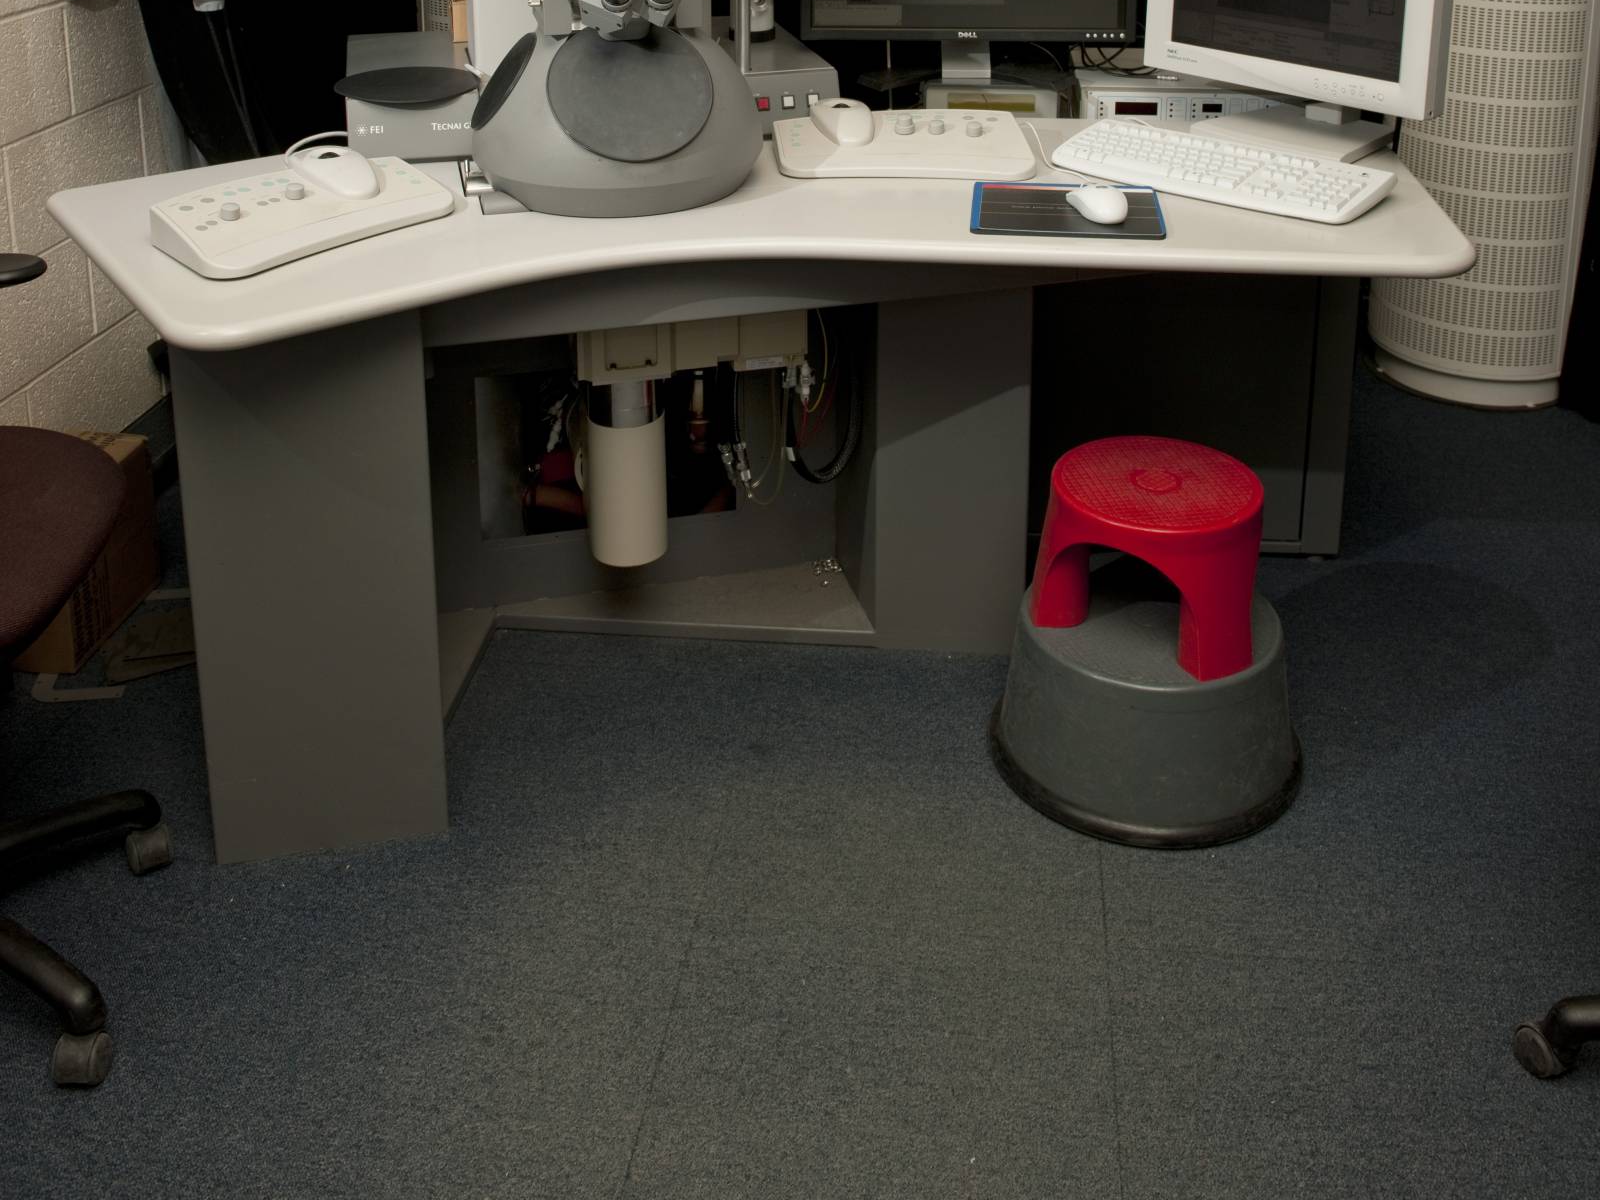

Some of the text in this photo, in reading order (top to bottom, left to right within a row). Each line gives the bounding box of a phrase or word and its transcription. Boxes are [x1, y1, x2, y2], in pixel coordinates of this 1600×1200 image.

[958, 31, 978, 39] DELL
[370, 125, 384, 134] FEI
[431, 122, 462, 131] TECNAI
